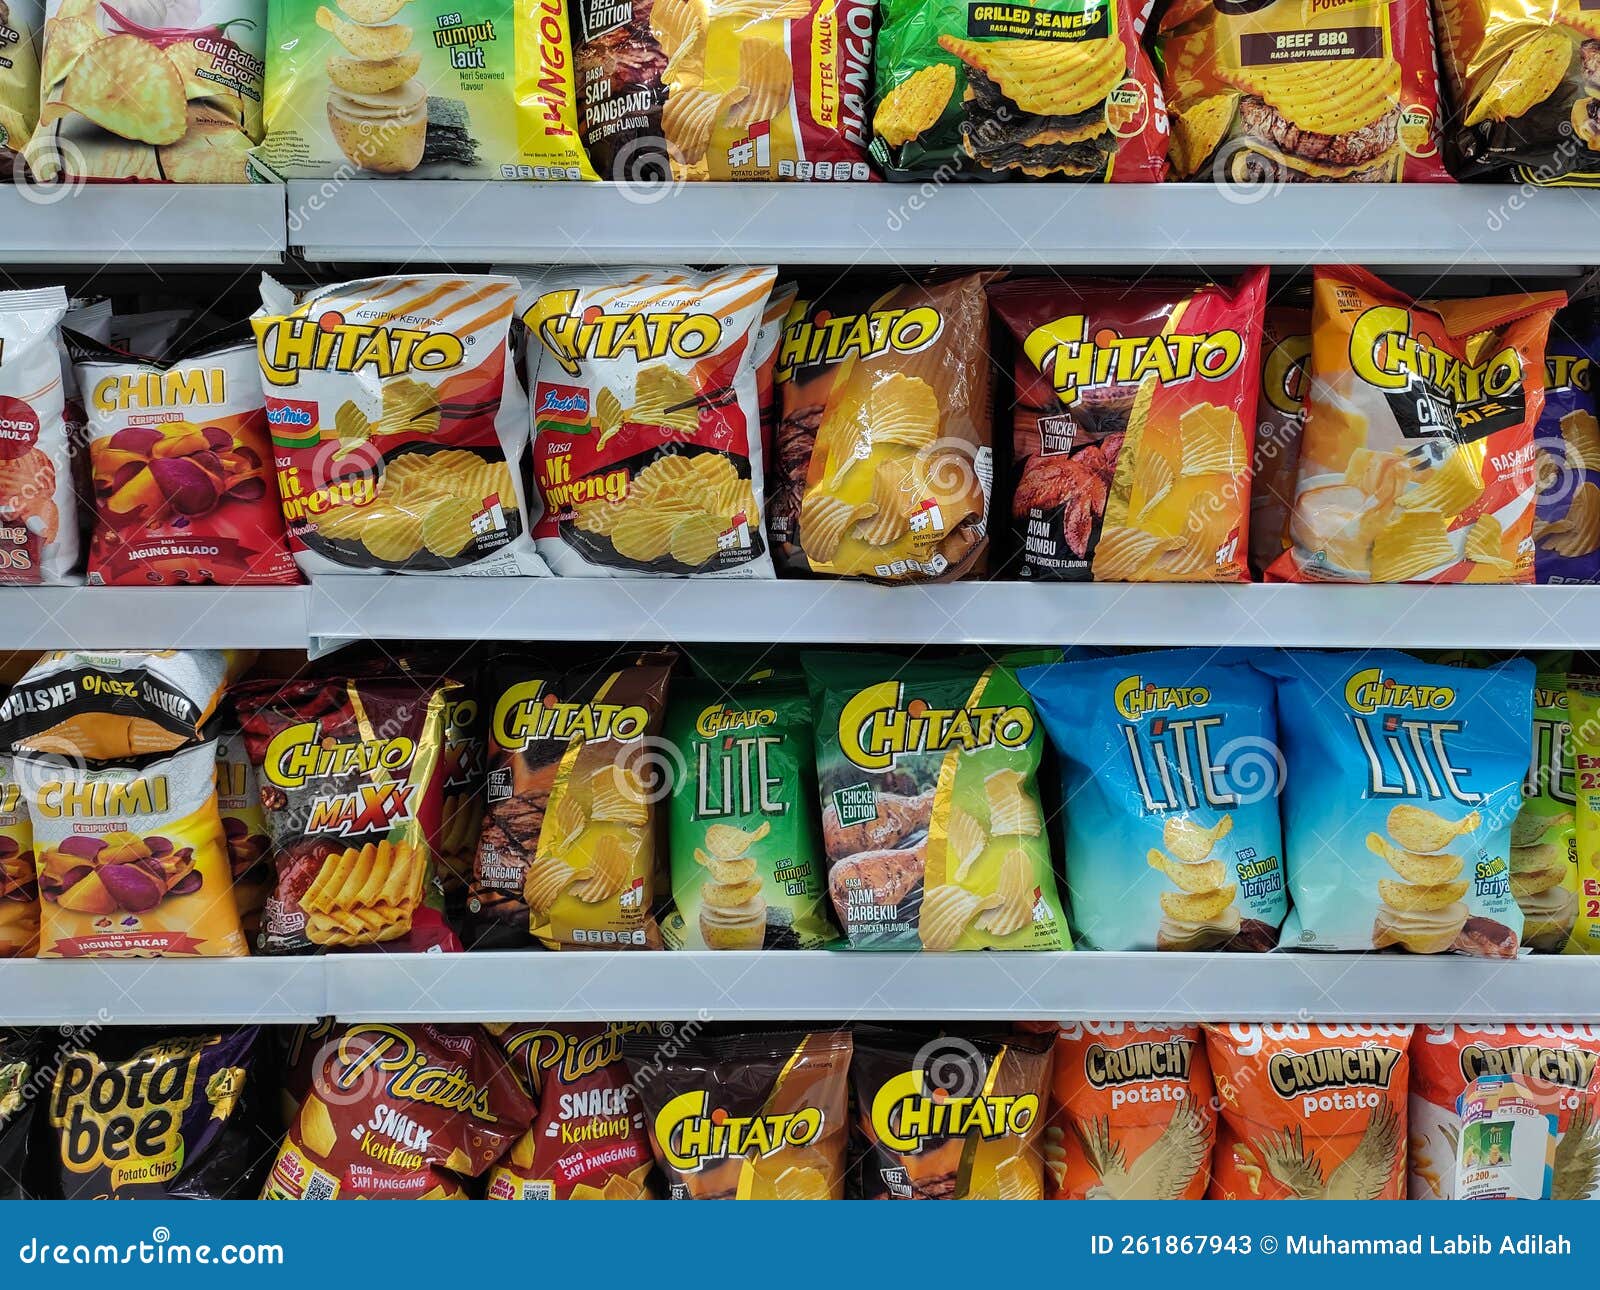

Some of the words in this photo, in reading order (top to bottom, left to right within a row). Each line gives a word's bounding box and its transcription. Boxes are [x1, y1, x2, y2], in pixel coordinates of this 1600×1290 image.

[438, 13, 462, 27] rasa
[589, 2, 632, 30] EDITION
[974, 6, 1030, 24] GRILLED
[1035, 9, 1101, 28] SEAWEED
[434, 22, 496, 47] rumput
[820, 12, 832, 55] VALUE
[990, 24, 1008, 33] RASA
[194, 37, 228, 56] Chili
[1276, 33, 1313, 48] BEEF
[1318, 31, 1349, 46] BBQ
[450, 48, 485, 69] laut
[1270, 51, 1289, 59] RASA
[1290, 50, 1306, 58] SAPI
[197, 69, 215, 81] Rasa
[215, 75, 241, 91] Sambal
[211, 57, 255, 84] Flavor
[585, 66, 604, 82] RASA
[585, 79, 611, 105] SAPI
[820, 62, 833, 122] BETTER
[586, 90, 651, 128] PANGGANG
[589, 127, 602, 144] BEEF
[616, 116, 650, 132] FLAVOUR
[654, 298, 701, 308] KENTANG
[356, 310, 397, 321] KERIPIK
[399, 315, 443, 327] KENTANG
[92, 368, 226, 413] CHIMI
[128, 414, 166, 425] KERIPIK
[166, 412, 184, 423] UBI
[1044, 418, 1077, 437] CHICKEN
[547, 442, 572, 455] Rasa
[1044, 436, 1072, 452] EDITION
[541, 453, 572, 486] Mi
[546, 470, 627, 513] goreng
[1030, 508, 1043, 519] RASA
[1027, 520, 1051, 536] AYAM
[475, 534, 493, 543] POTATO
[1025, 537, 1057, 556] BUMBU
[128, 546, 170, 561] JAGUNG
[171, 546, 219, 556] BALADO
[1036, 556, 1060, 568] CHICKEN
[1060, 558, 1088, 569] FLAVOUR
[82, 675, 139, 698] 25%
[490, 772, 506, 785] BEEF
[37, 775, 170, 818] CHIMI
[842, 790, 880, 804] CHICKEN
[842, 804, 876, 819] EDITION
[73, 823, 109, 833] KERIPIK
[109, 822, 127, 833] UBI
[482, 852, 500, 865] SAPI
[1237, 848, 1255, 860] rasa
[481, 866, 522, 880] PANGGANG
[774, 864, 811, 883] rumput
[776, 859, 793, 869] rasa
[1237, 857, 1277, 880] Salmon
[786, 880, 807, 896] laut
[845, 879, 862, 887] RASA
[1241, 873, 1281, 899] Teriyaki
[847, 889, 874, 906] AYAM
[847, 906, 897, 921] BARBEKIU
[859, 924, 885, 934] CHICKEN
[885, 924, 910, 932] FLAVOUR
[78, 939, 122, 950] JAGUNG
[124, 937, 169, 948] BAKAR
[337, 1023, 498, 1122] Piattos
[1086, 1040, 1198, 1089] CRUNCHY
[1269, 1047, 1402, 1098] CRUNCHY
[57, 1057, 191, 1117] Pota
[1112, 1084, 1185, 1109] potato
[558, 1087, 629, 1120] SNACK
[1303, 1091, 1380, 1117] potato
[68, 1104, 173, 1164] bee
[368, 1104, 432, 1152] SNACK
[561, 1117, 630, 1144] Kentang
[360, 1131, 422, 1171] Kentang
[558, 1151, 584, 1169] Rasa
[118, 1167, 148, 1182] Potato
[149, 1160, 177, 1177] Chips
[350, 1163, 373, 1175] Rasa
[564, 1164, 585, 1180] SAPI
[586, 1146, 637, 1171] PANGGANG
[351, 1176, 371, 1189] SAPI
[373, 1176, 426, 1190] PANGGANG
[886, 1171, 903, 1183] BEEF
